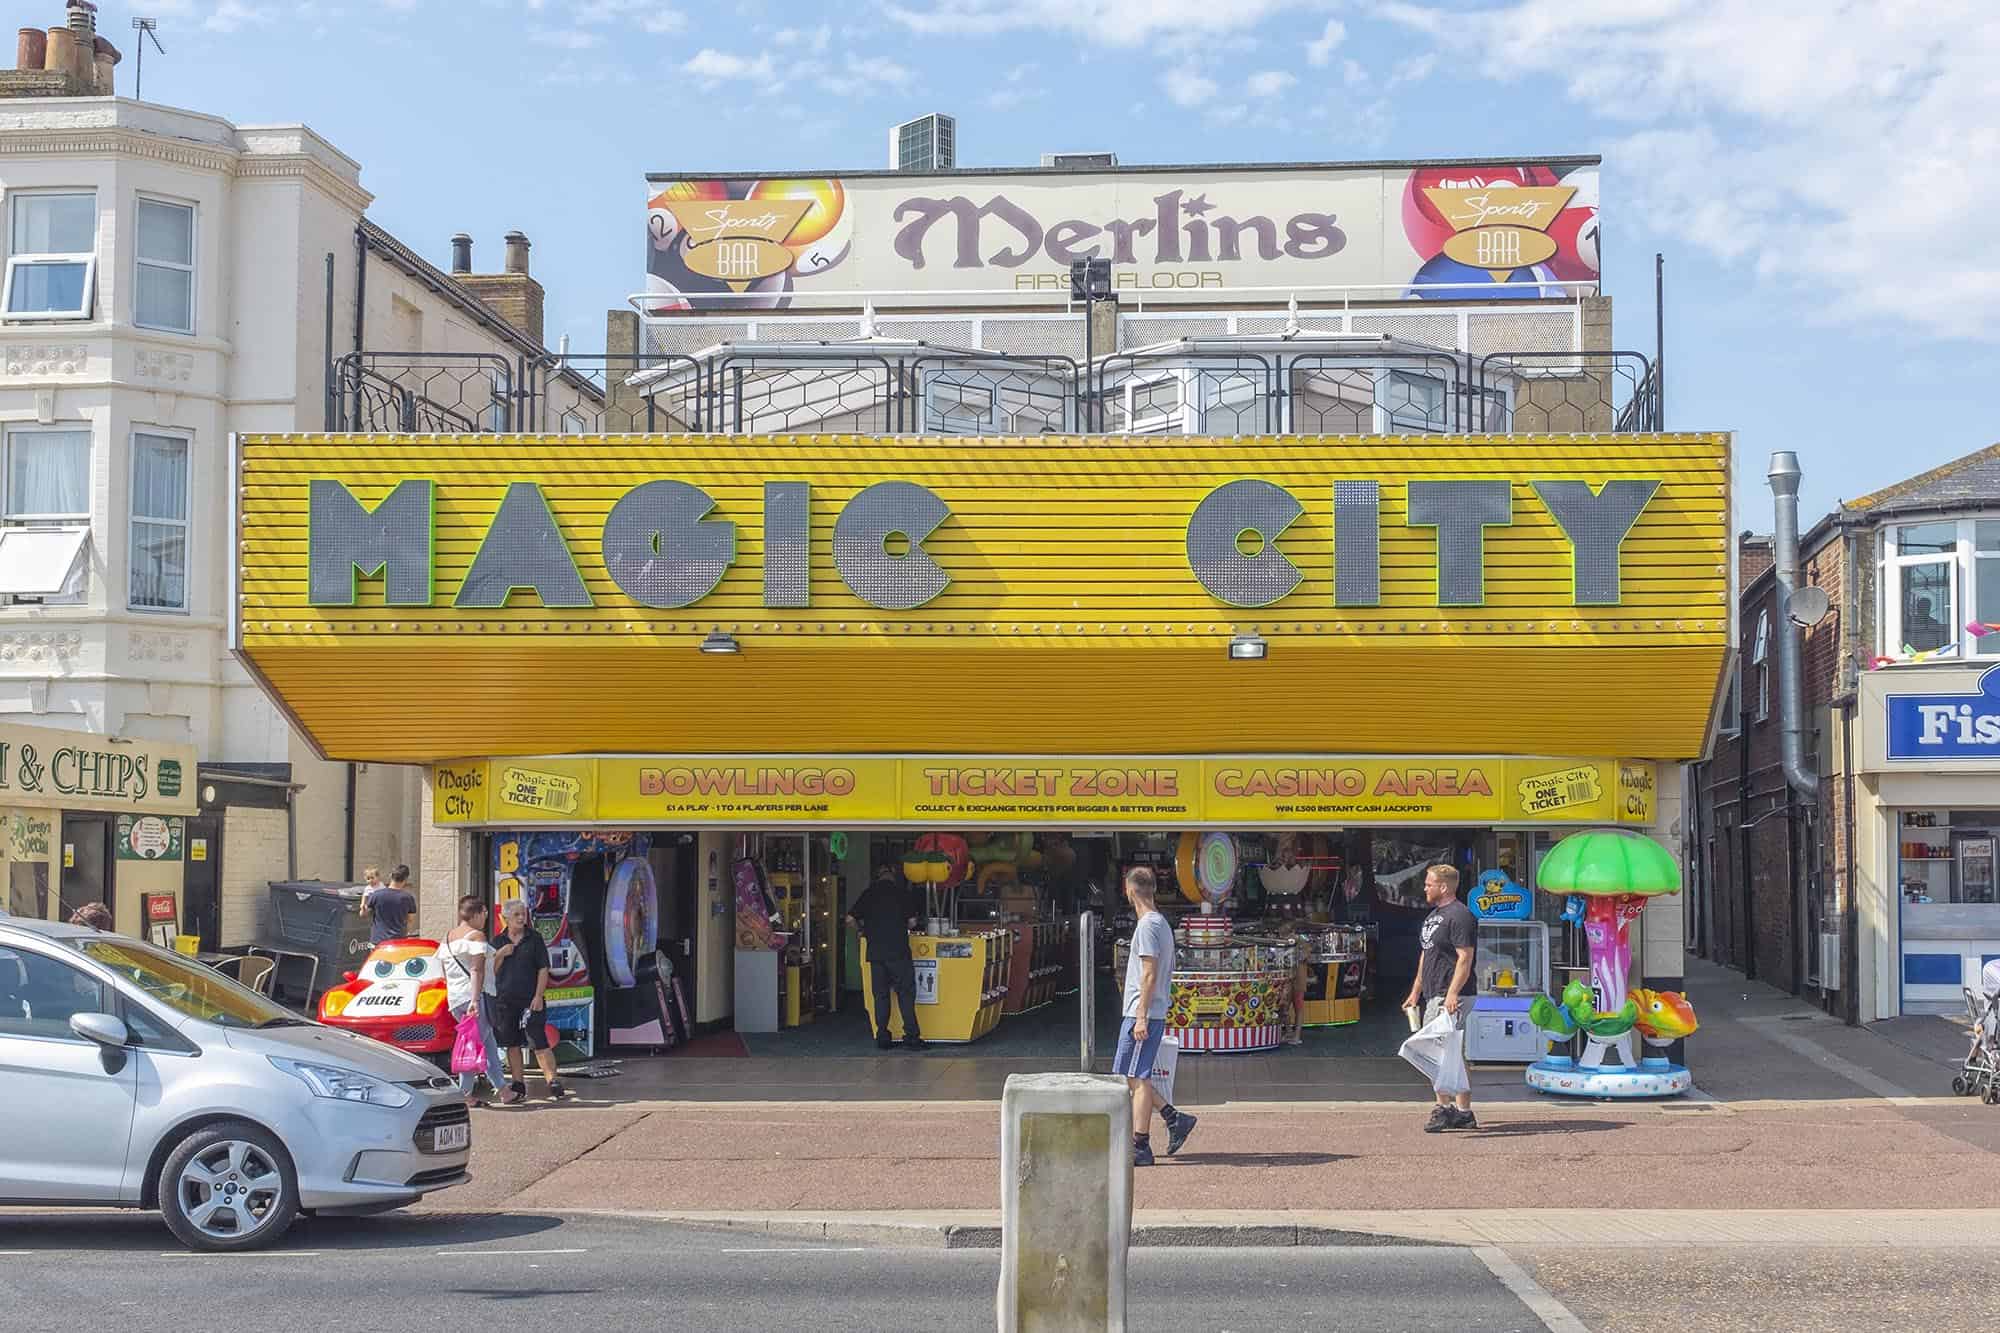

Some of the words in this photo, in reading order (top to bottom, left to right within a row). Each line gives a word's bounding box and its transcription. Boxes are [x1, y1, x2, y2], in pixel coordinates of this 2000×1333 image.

[693, 204, 784, 240] Sports
[1452, 191, 1553, 227] Sports
[894, 189, 1348, 269] Merlins
[717, 243, 760, 275] BAR
[1478, 231, 1521, 264] BAR
[1015, 273, 1073, 290] FIRS
[1116, 272, 1223, 289] FLOOR
[308, 479, 952, 611] MAGIC
[1186, 478, 1663, 608] CITY
[18, 743, 44, 793] &
[51, 745, 149, 803] CHIPS
[438, 768, 482, 791] Magic
[511, 770, 546, 787] Magic
[549, 777, 573, 790] City
[639, 767, 856, 796] BOWLINGO
[924, 767, 1063, 797] TICKET
[1070, 768, 1178, 797] ZONE
[1214, 768, 1366, 797] CASINO
[1373, 768, 1493, 797] AREA
[1526, 776, 1563, 789] Magic
[1566, 769, 1591, 783] City
[1621, 767, 1653, 793] Magic
[508, 791, 544, 807] TICKET
[516, 783, 537, 796] ONE
[1535, 787, 1558, 800] ONE
[445, 794, 474, 820] City
[666, 804, 676, 812] £1
[686, 804, 709, 812] PLAY
[721, 804, 734, 812] TO
[742, 804, 784, 812] PLAYERS
[784, 804, 802, 812] PER
[804, 804, 829, 812] LANE
[915, 804, 955, 813] COLLECT
[966, 804, 1017, 813] EXCHANGE
[1018, 804, 1054, 813] TICKETS
[1056, 804, 1075, 813] FOR
[1076, 804, 1110, 813] BIGGER
[1119, 804, 1154, 813] BETTER
[1156, 804, 1187, 813] PRIZES
[1275, 804, 1294, 813] WIN
[1295, 804, 1317, 813] £500
[1317, 804, 1354, 813] INSTANT
[1355, 804, 1382, 813] CASH
[1383, 804, 1433, 813] JACKPOTS!
[1529, 795, 1567, 811] TICKET
[1626, 794, 1647, 821] City
[357, 995, 404, 1006] POLICE
